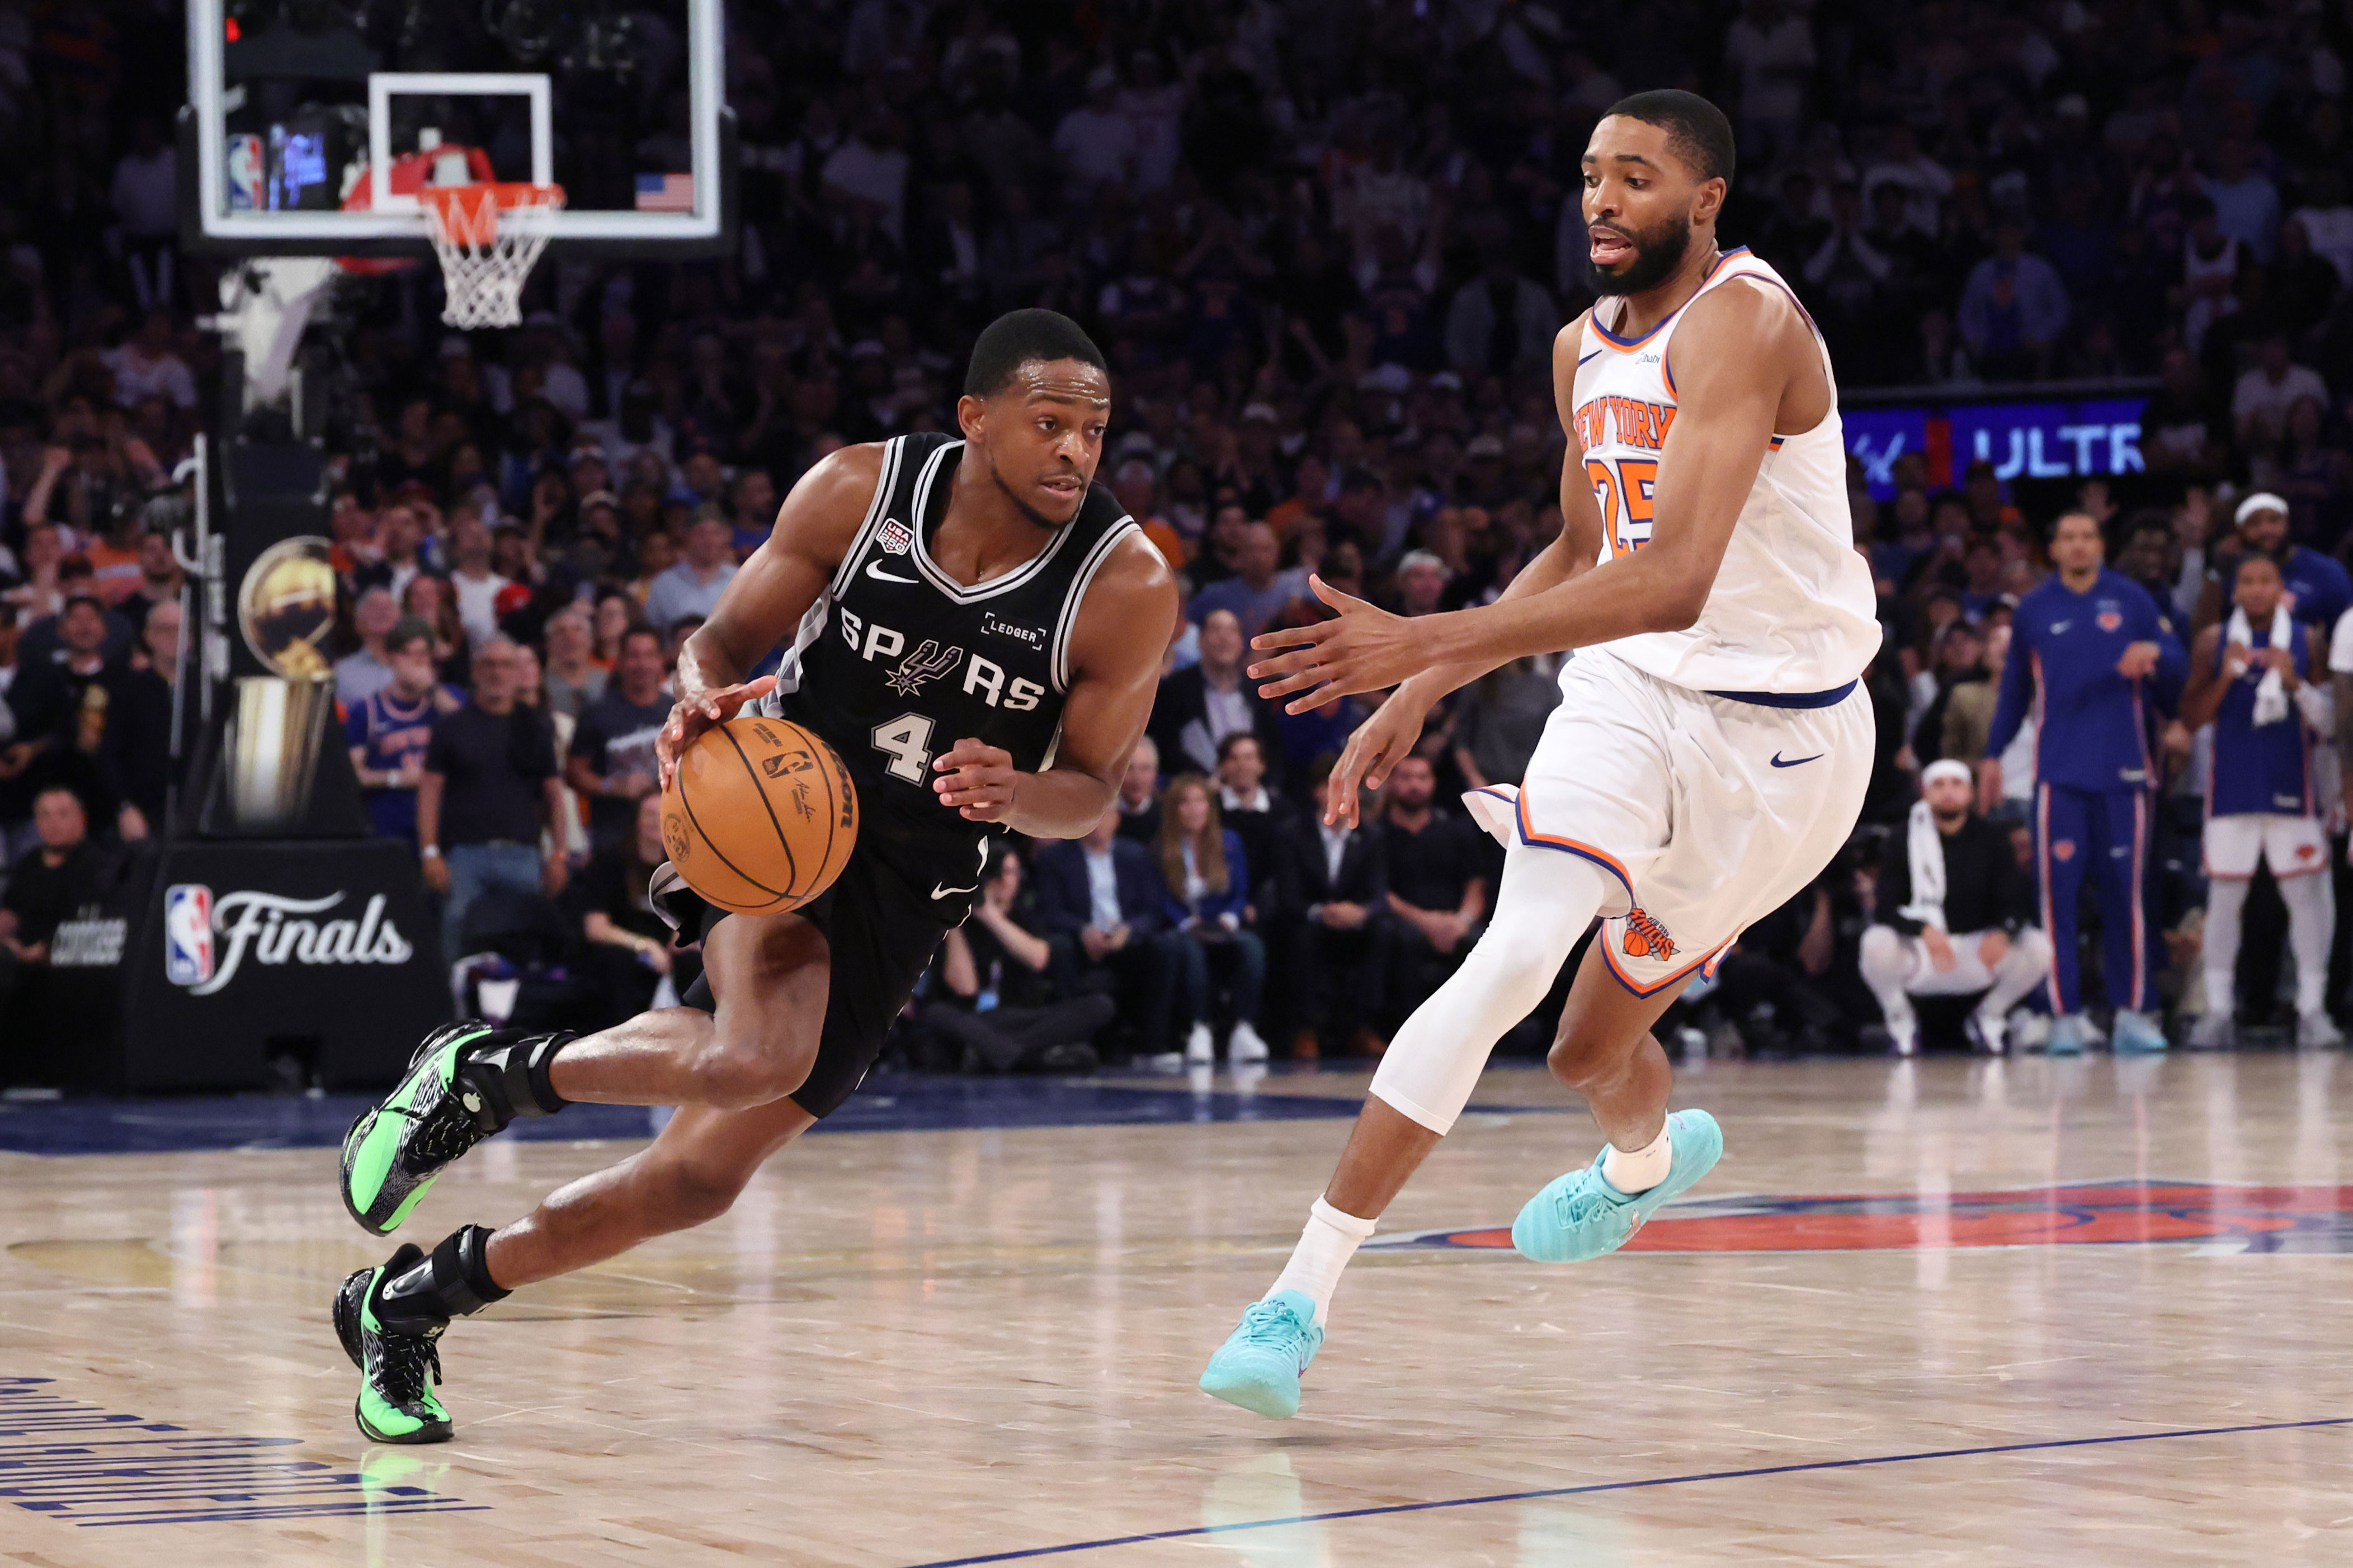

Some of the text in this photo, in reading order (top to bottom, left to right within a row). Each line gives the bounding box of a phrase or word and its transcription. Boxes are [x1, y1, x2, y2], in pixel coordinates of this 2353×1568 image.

[879, 532, 905, 552] 250
[887, 522, 909, 541] USA
[991, 620, 1036, 643] LEDGER
[841, 606, 1045, 711] SPURS
[871, 711, 936, 787] 4
[188, 891, 413, 995] Finals
[1629, 908, 1675, 961] KNICKS
